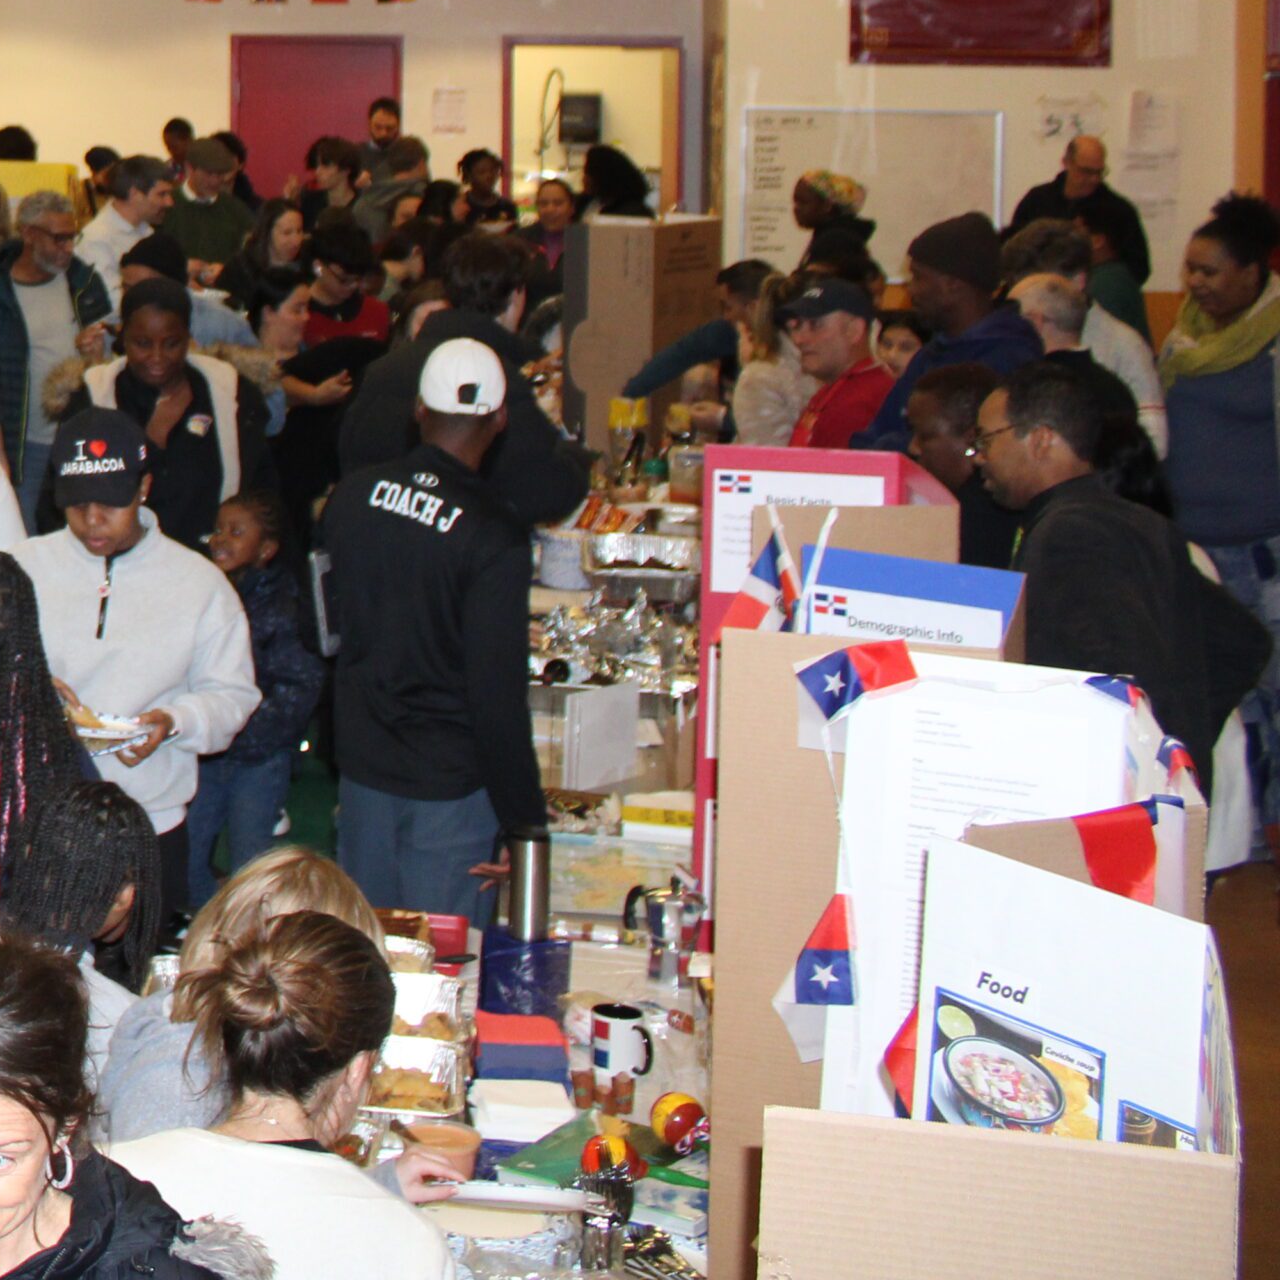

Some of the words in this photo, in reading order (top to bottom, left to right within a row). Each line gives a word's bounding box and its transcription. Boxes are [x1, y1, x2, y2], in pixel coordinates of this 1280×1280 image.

[73, 439, 88, 461] I
[60, 457, 126, 477] JARABACOA
[368, 479, 444, 526] COACH
[436, 506, 464, 533] J
[847, 614, 934, 642] Demographic
[936, 628, 964, 645] Info
[976, 971, 1030, 1005] Food
[1044, 1046, 1076, 1067] Ceviche
[1076, 1059, 1097, 1073] soup
